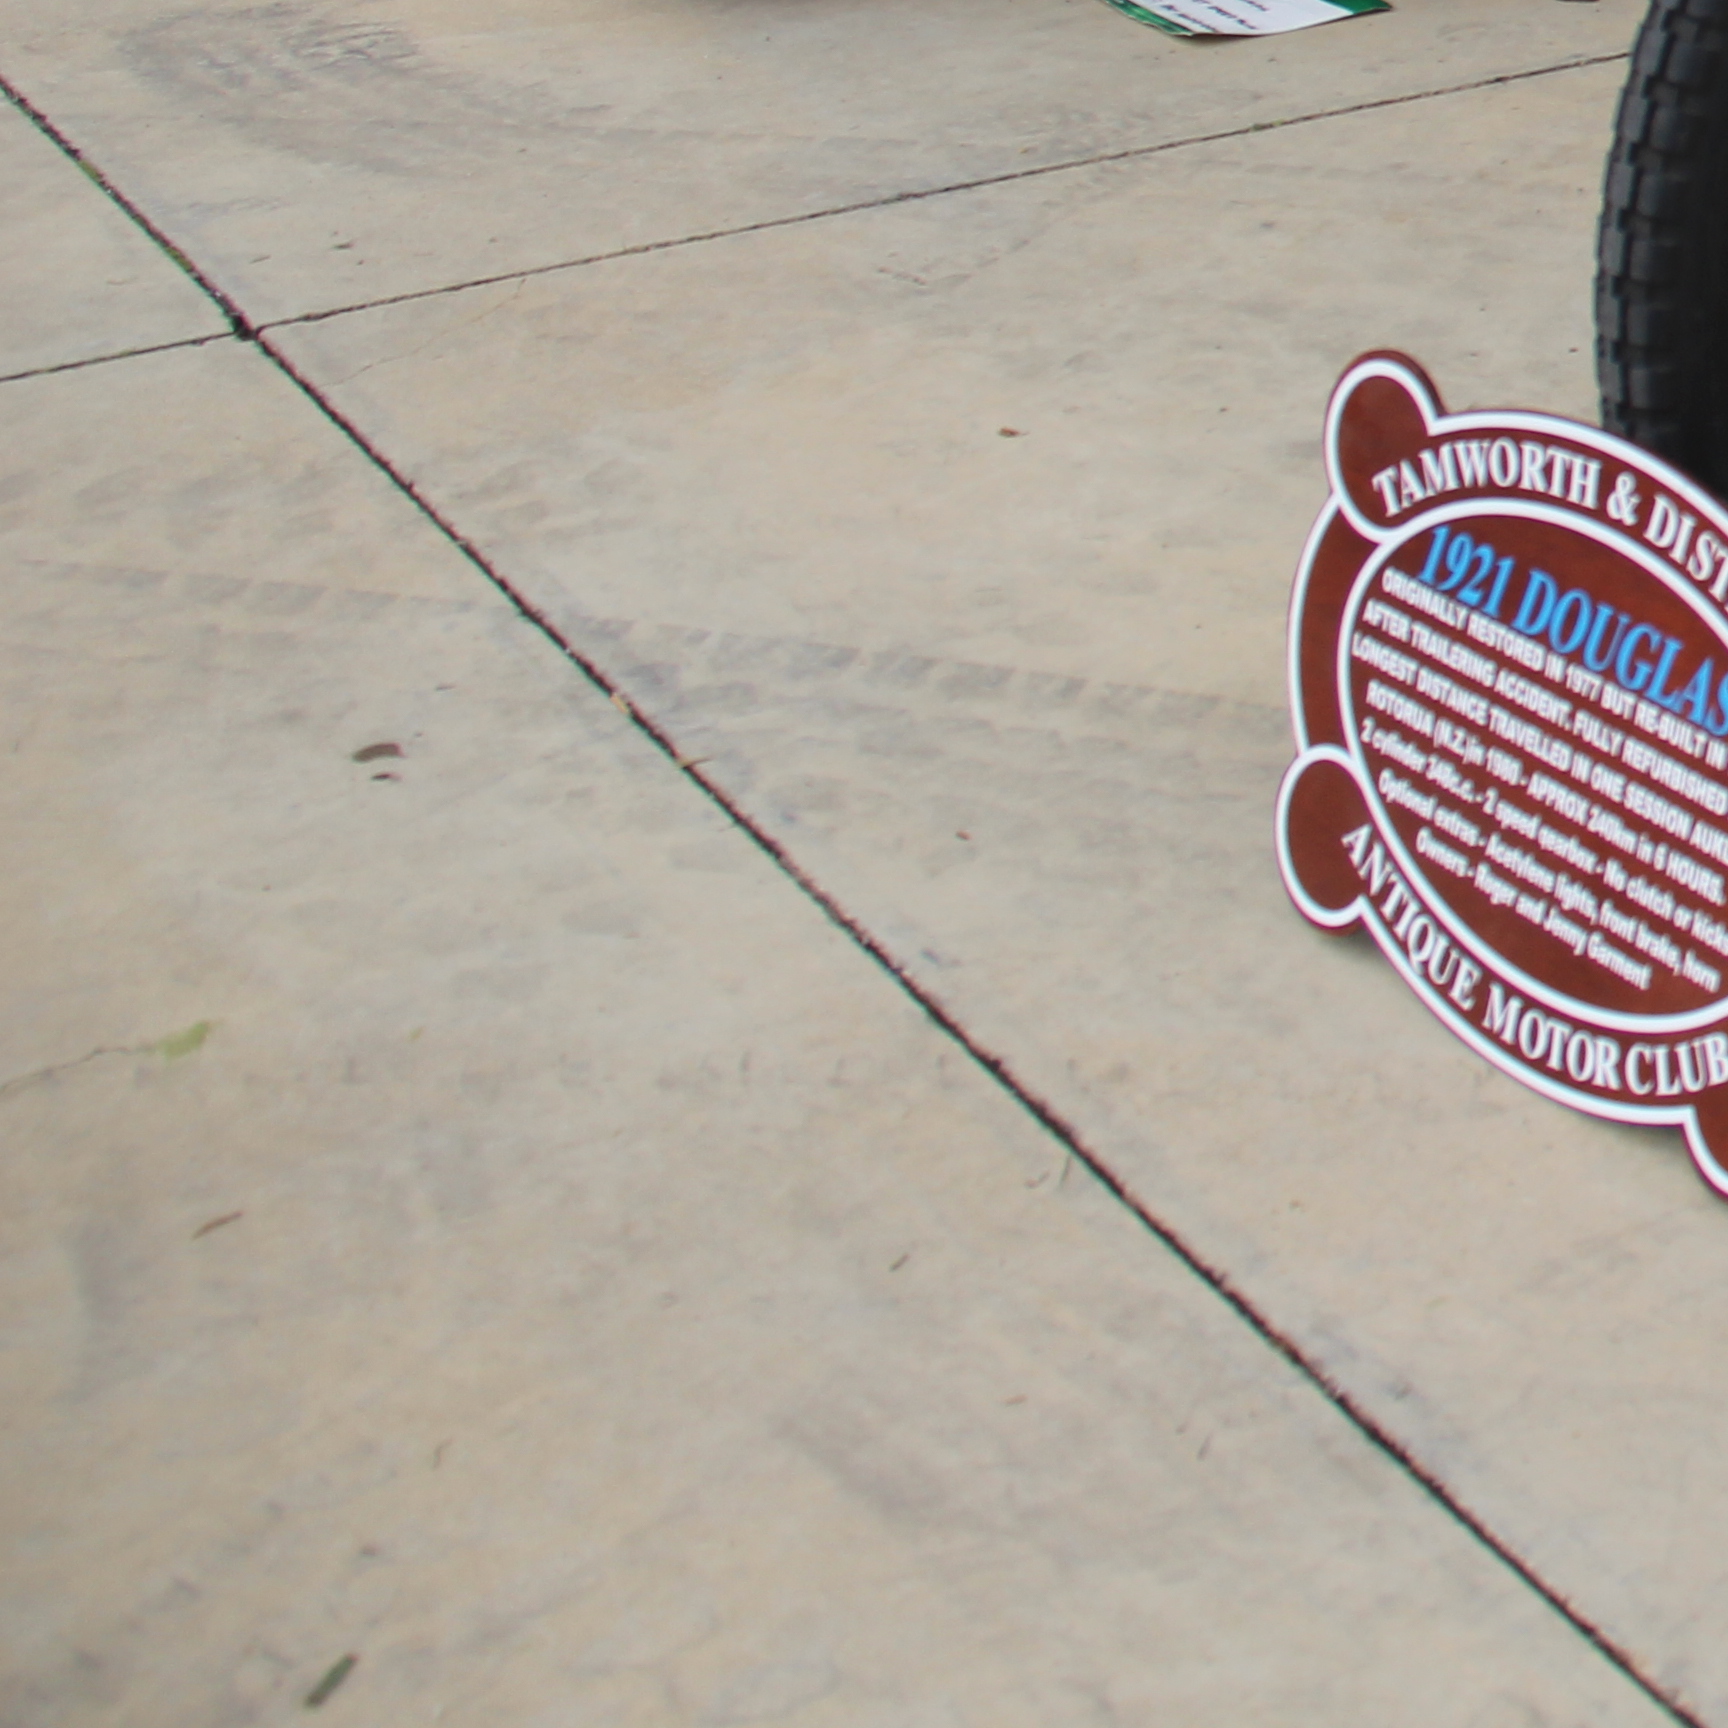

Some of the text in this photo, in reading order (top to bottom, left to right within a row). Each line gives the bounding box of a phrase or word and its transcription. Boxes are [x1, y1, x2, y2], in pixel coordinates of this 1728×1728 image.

[1372, 436, 1601, 519] TAMWORTH
[1605, 471, 1641, 527] &
[1417, 523, 1516, 619] 1921
[1351, 630, 1420, 686] LONGEST
[1415, 666, 1491, 727] DISTANCE
[1488, 703, 1575, 773] TRAVELLED
[1570, 750, 1594, 784] IN
[1590, 762, 1629, 804] ONE
[1623, 780, 1695, 841] SESSION
[1361, 597, 1413, 643] AFTER
[1410, 620, 1499, 688] TRAILERING
[1572, 708, 1626, 758] FULLY
[1381, 565, 1470, 631] ORIGINALLY
[1466, 609, 1548, 673] RESTORED
[1543, 650, 1568, 684] IN
[1565, 662, 1604, 702] 1977
[1600, 681, 1638, 721] BUT
[1633, 698, 1709, 759] RE-BUILT
[1360, 716, 1376, 744] 2
[1371, 727, 1429, 774] cylinder
[1482, 786, 1498, 816] 2
[1494, 798, 1542, 841] speed
[1537, 825, 1599, 875] gearbox
[1602, 857, 1629, 893] No
[1625, 874, 1676, 921] clutch
[1672, 904, 1695, 932] or
[1365, 678, 1436, 739] ROTORUA
[1526, 771, 1591, 827] APPROX
[1635, 832, 1657, 865] in
[1652, 842, 1670, 872] 6
[1341, 822, 1484, 1012] ANTIQUE
[1482, 981, 1623, 1092] MOTOR
[1378, 767, 1439, 822] Optional
[1433, 805, 1482, 848] extras
[1484, 831, 1558, 893] Acetylene
[1599, 898, 1639, 945] front
[1682, 948, 1723, 994] horn
[1415, 825, 1471, 878] Owners
[1473, 861, 1520, 907] Roger
[1514, 892, 1549, 925] and
[1543, 906, 1590, 957] Jenny
[1586, 930, 1653, 992] Garment
